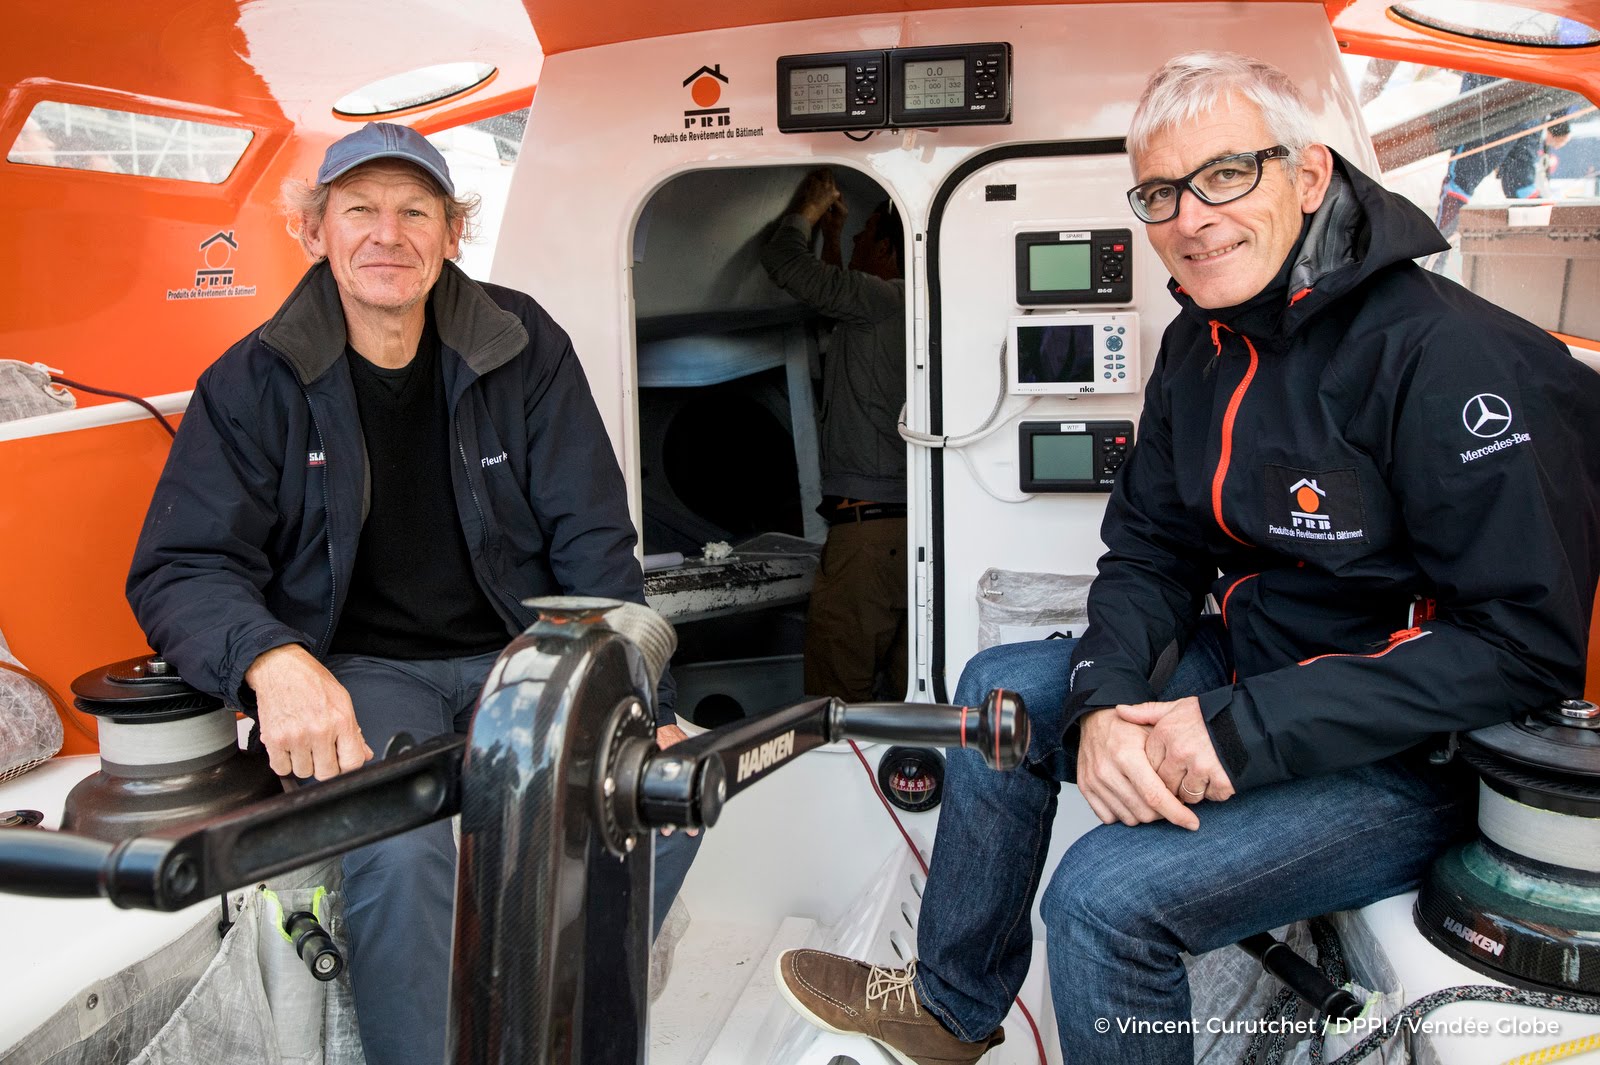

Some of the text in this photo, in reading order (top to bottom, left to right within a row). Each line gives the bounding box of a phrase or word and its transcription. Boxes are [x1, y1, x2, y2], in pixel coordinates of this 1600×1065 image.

[927, 67, 943, 76] 0.0
[807, 73, 829, 83] 0.00
[684, 115, 731, 129] PRB
[653, 127, 764, 144] Produits de Revêtement du Bâtiment
[196, 276, 233, 287] PRB
[168, 290, 189, 299] Produits
[190, 289, 196, 298] de
[228, 288, 233, 296] du
[1079, 385, 1095, 393] nke
[481, 454, 502, 468] Fleur
[1292, 517, 1331, 530] PRB
[1327, 532, 1335, 540] du
[1336, 528, 1363, 540] Bâtiment
[736, 729, 795, 783] HARKEN
[1443, 916, 1505, 957] HARKEN
